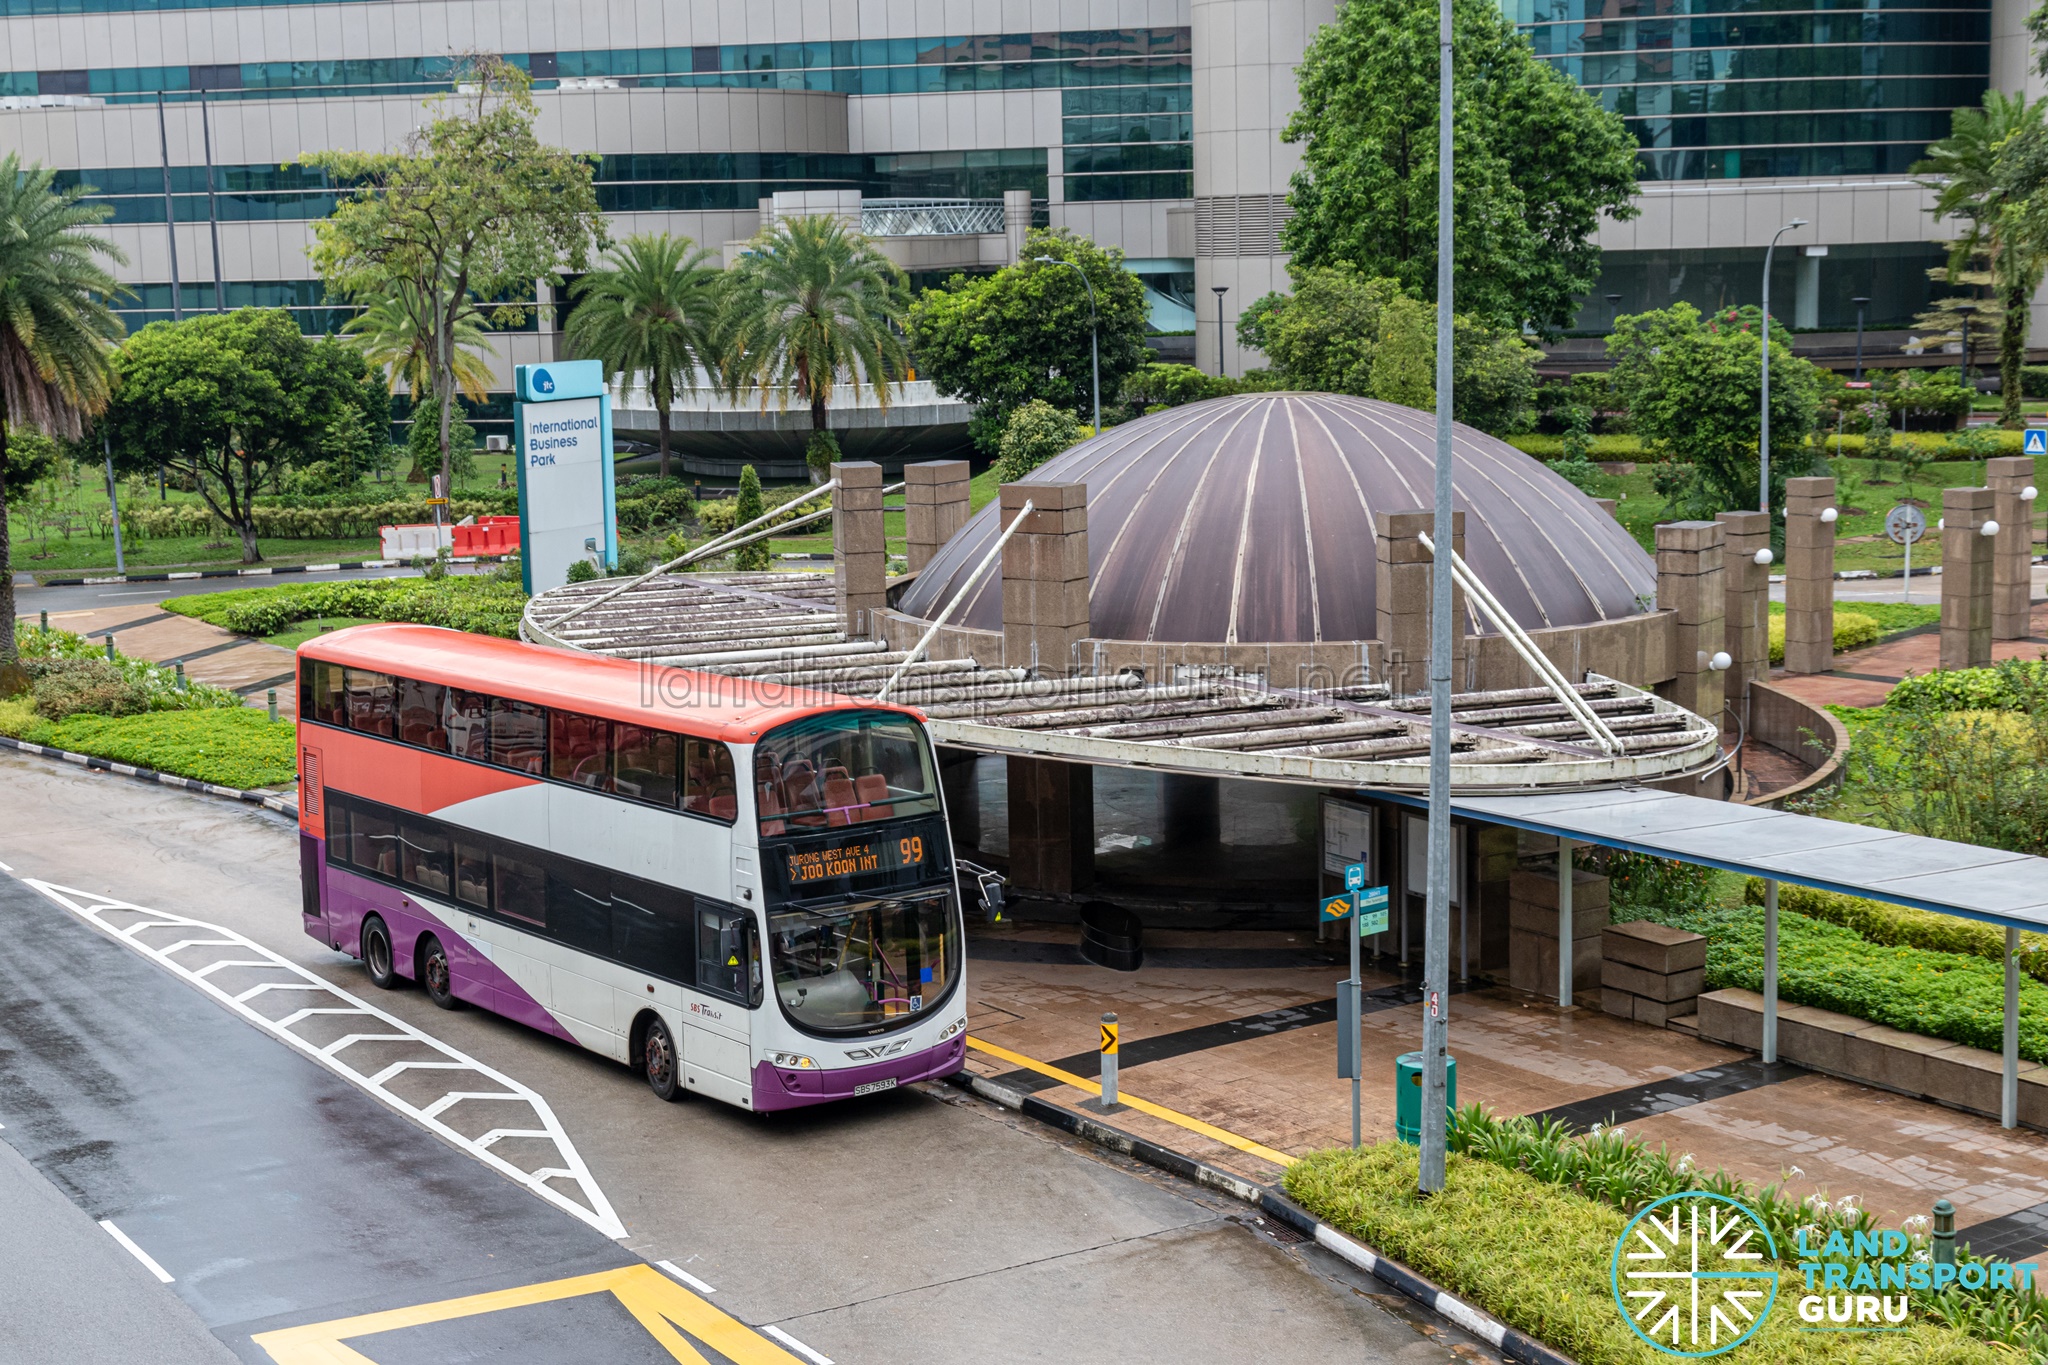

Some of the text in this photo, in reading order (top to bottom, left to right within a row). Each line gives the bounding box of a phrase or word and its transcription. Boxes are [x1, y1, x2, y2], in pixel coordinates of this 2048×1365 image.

[529, 416, 598, 435] International
[530, 437, 578, 451] Business
[531, 453, 556, 467] Park
[788, 844, 869, 867] JURONG WEST AVE 4
[900, 836, 923, 864] 99
[801, 855, 878, 881] JOO KOON INT
[690, 1003, 700, 1013] SBS
[855, 1079, 896, 1095] SBS7593K
